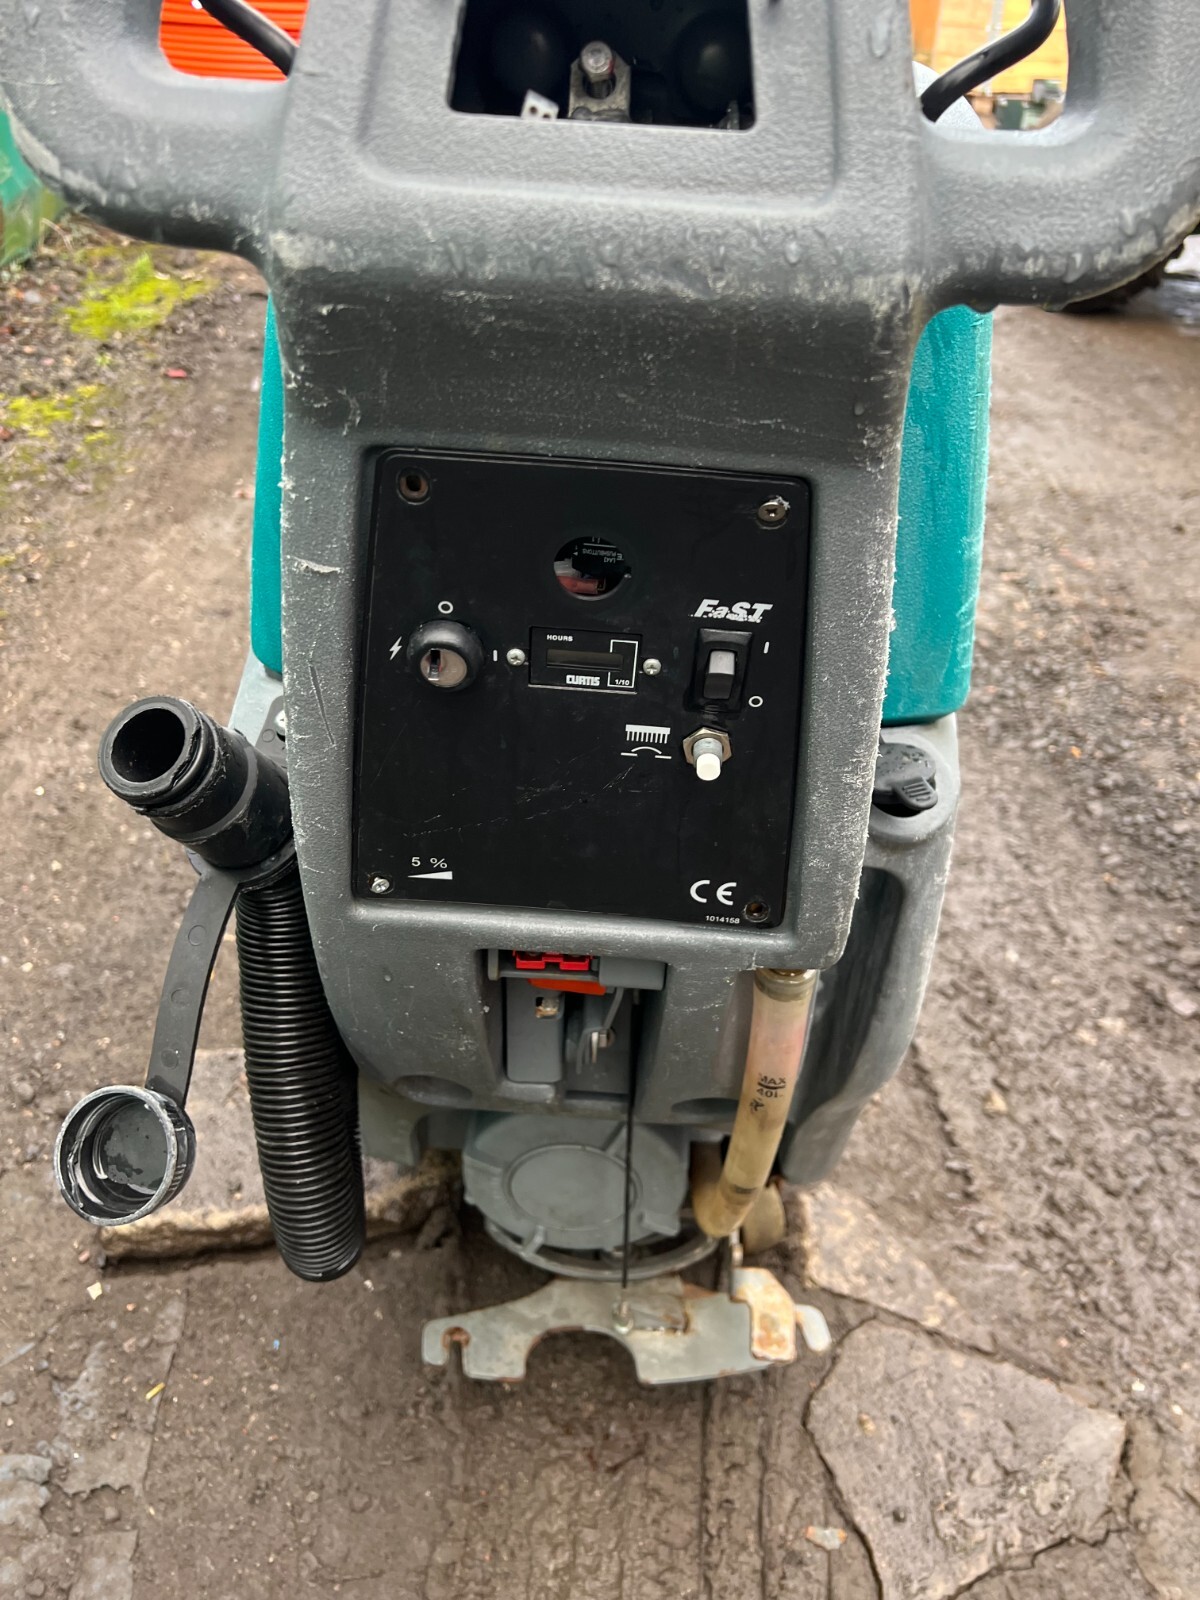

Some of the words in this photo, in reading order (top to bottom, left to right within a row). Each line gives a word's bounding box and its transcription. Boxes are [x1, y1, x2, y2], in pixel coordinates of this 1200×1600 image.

[546, 634, 574, 642] HOURS
[565, 674, 600, 686] CURTIS
[411, 856, 421, 867] 5
[429, 857, 448, 869] %
[705, 915, 741, 924] 1014158
